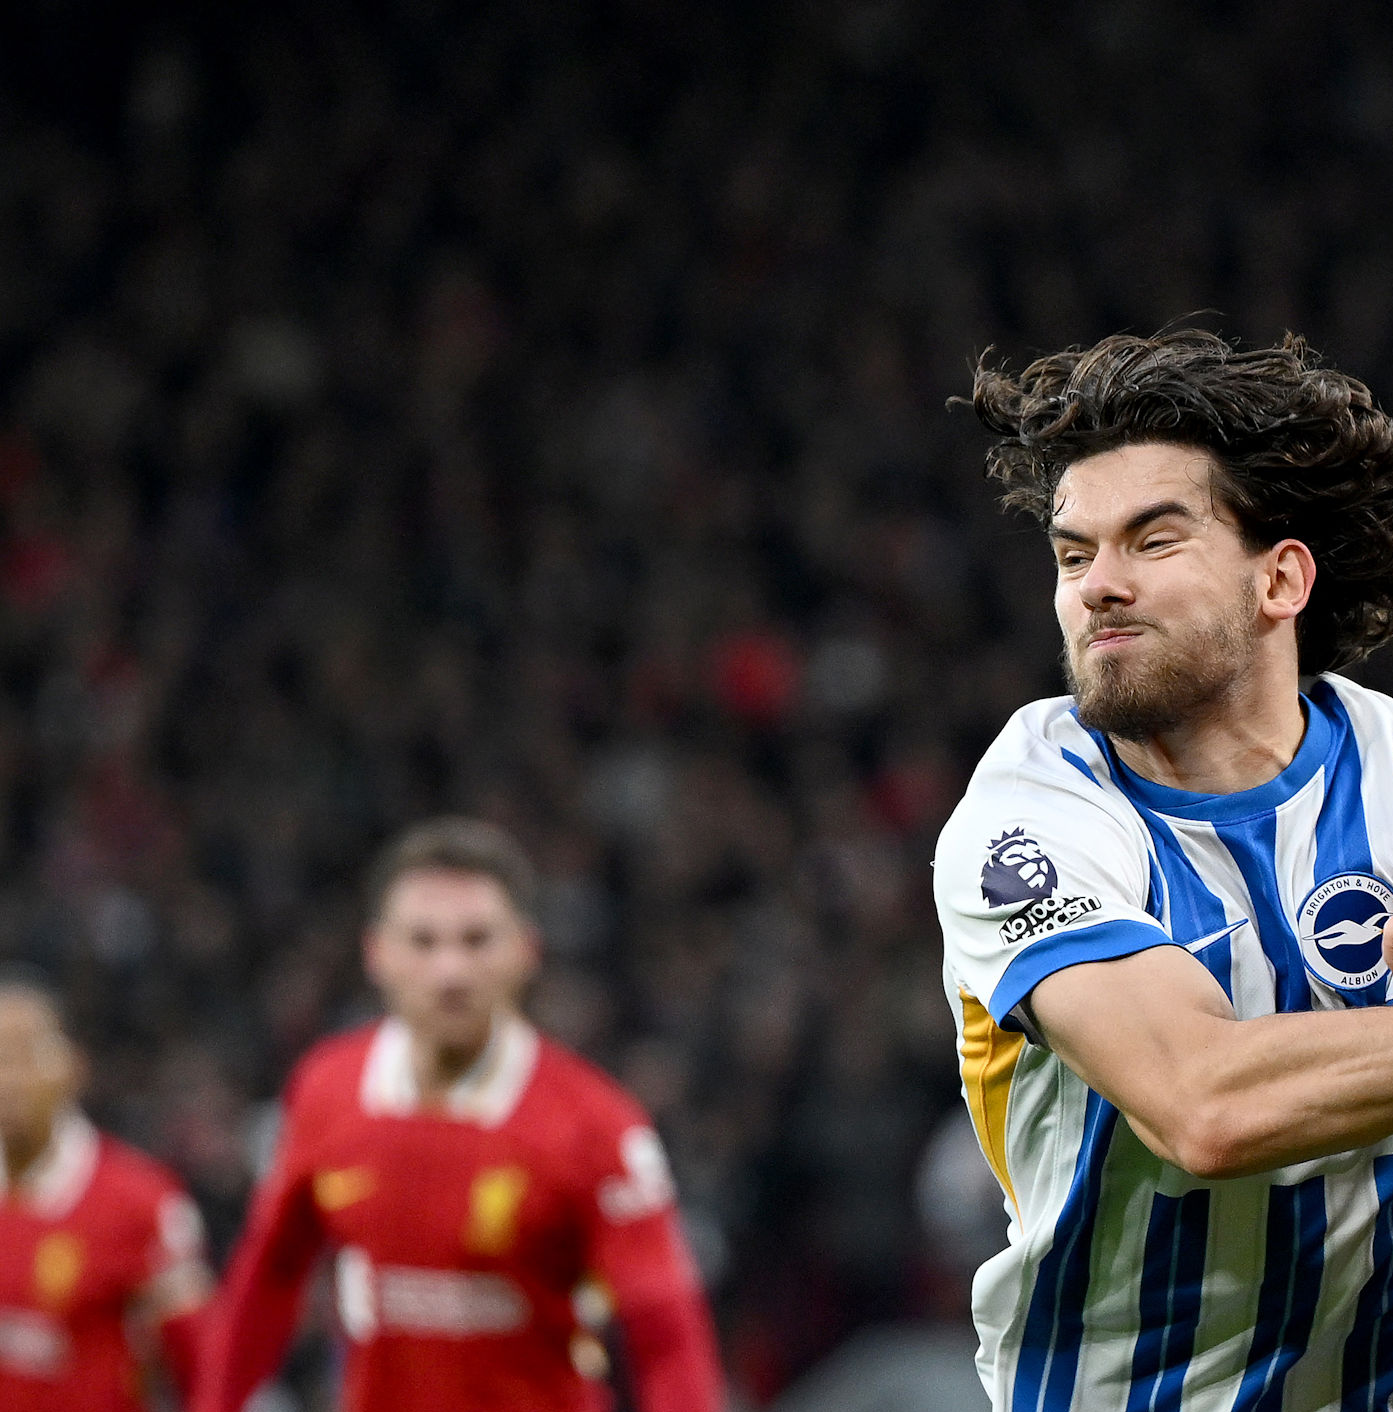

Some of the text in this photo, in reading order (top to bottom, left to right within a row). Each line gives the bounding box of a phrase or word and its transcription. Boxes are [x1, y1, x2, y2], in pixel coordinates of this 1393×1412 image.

[1306, 878, 1391, 916] BRIGHTON & HOVE
[1000, 917, 1027, 945] No
[1025, 896, 1068, 925] roo
[1340, 970, 1379, 986] ALBION
